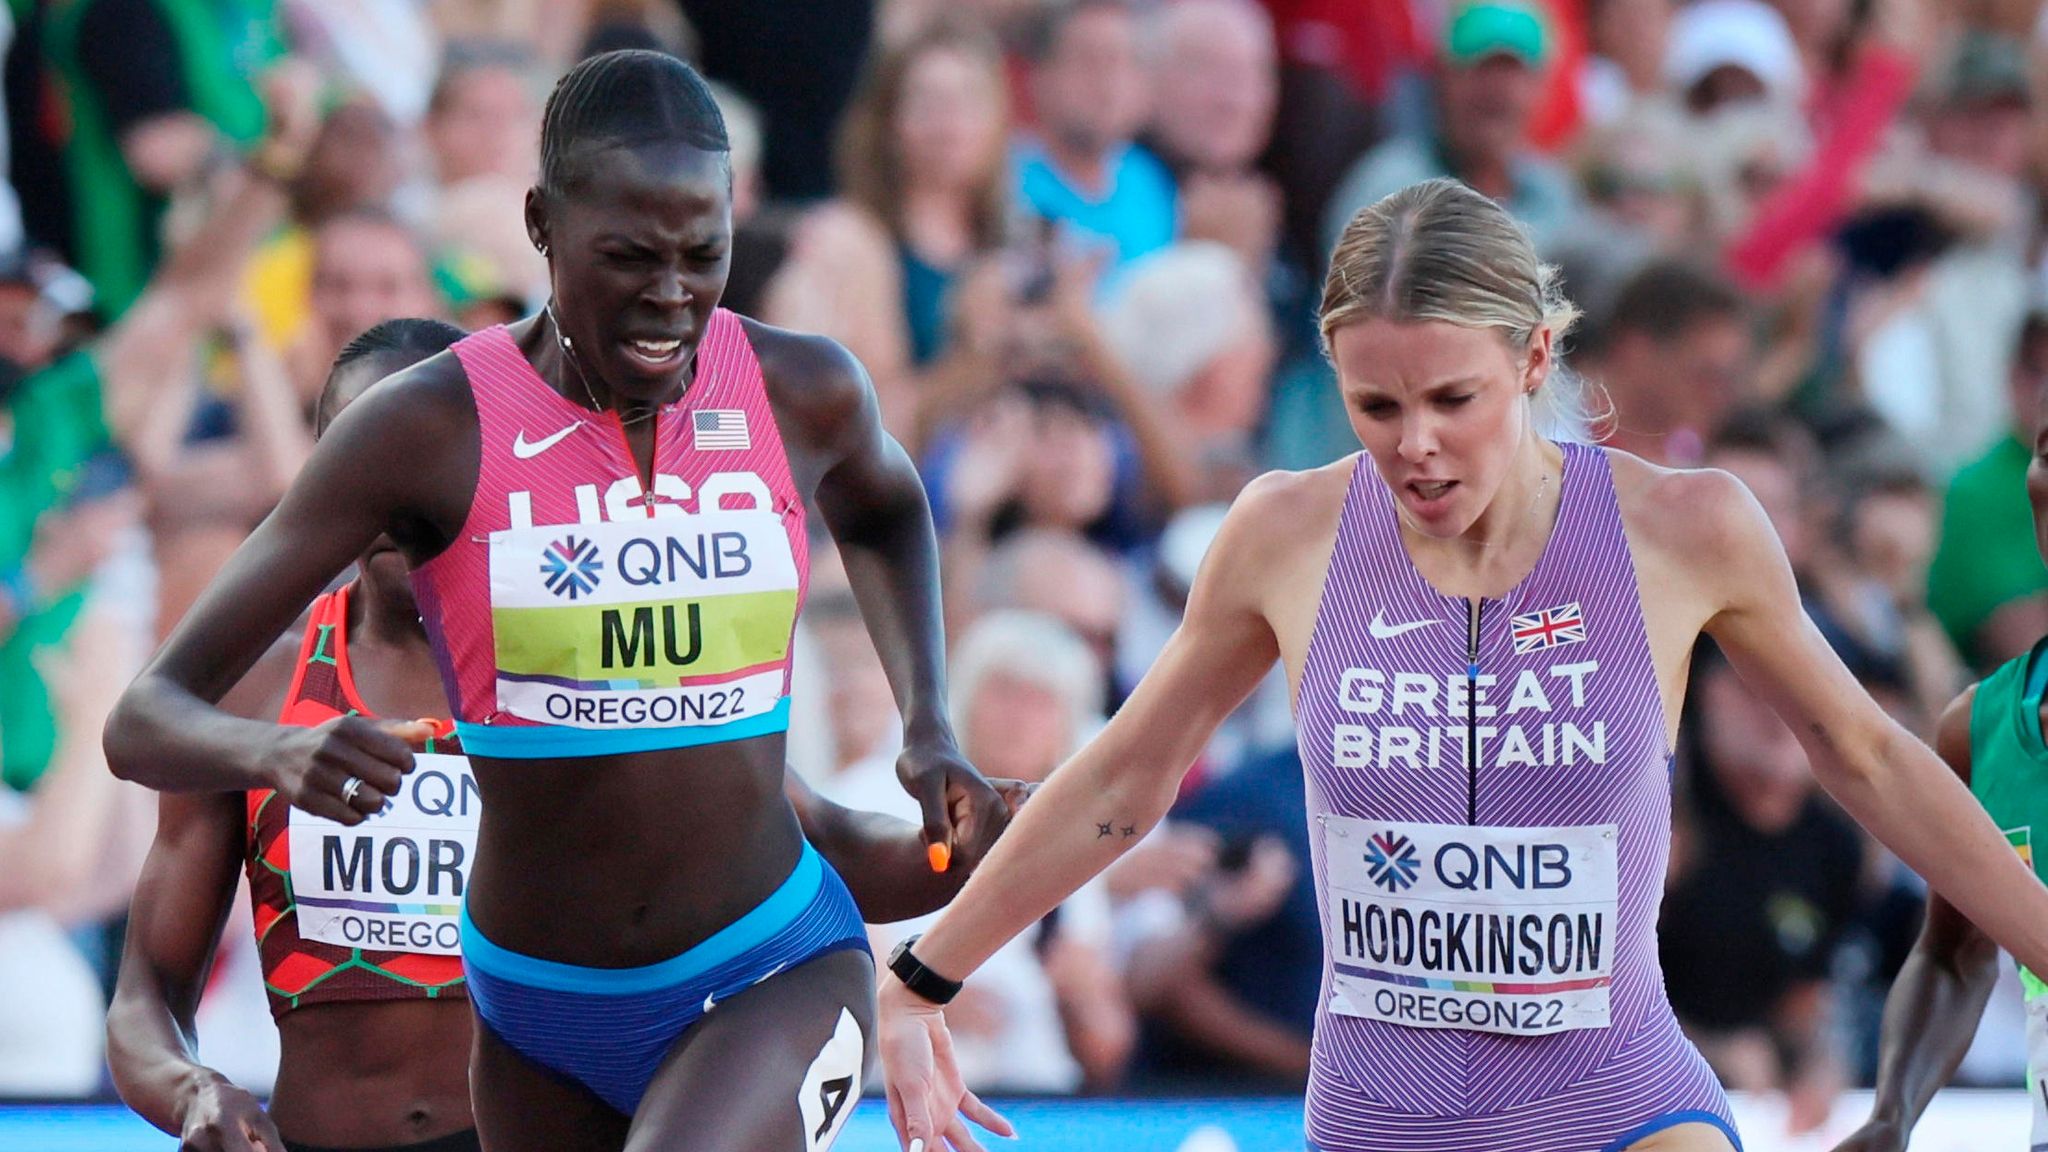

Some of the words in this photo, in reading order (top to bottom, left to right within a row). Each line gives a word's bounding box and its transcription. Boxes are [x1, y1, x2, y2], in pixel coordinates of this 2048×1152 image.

[617, 531, 752, 586] QNB
[601, 602, 703, 669] MU
[545, 687, 746, 724] OREGON22
[1338, 660, 1600, 718] GREAT
[1333, 720, 1606, 769] BRITAIN
[322, 835, 465, 897] MOR
[1434, 842, 1572, 891] QNB
[342, 916, 459, 948] OREGO
[1342, 898, 1603, 976] HODGKINSON
[1374, 988, 1564, 1029] OREGON22
